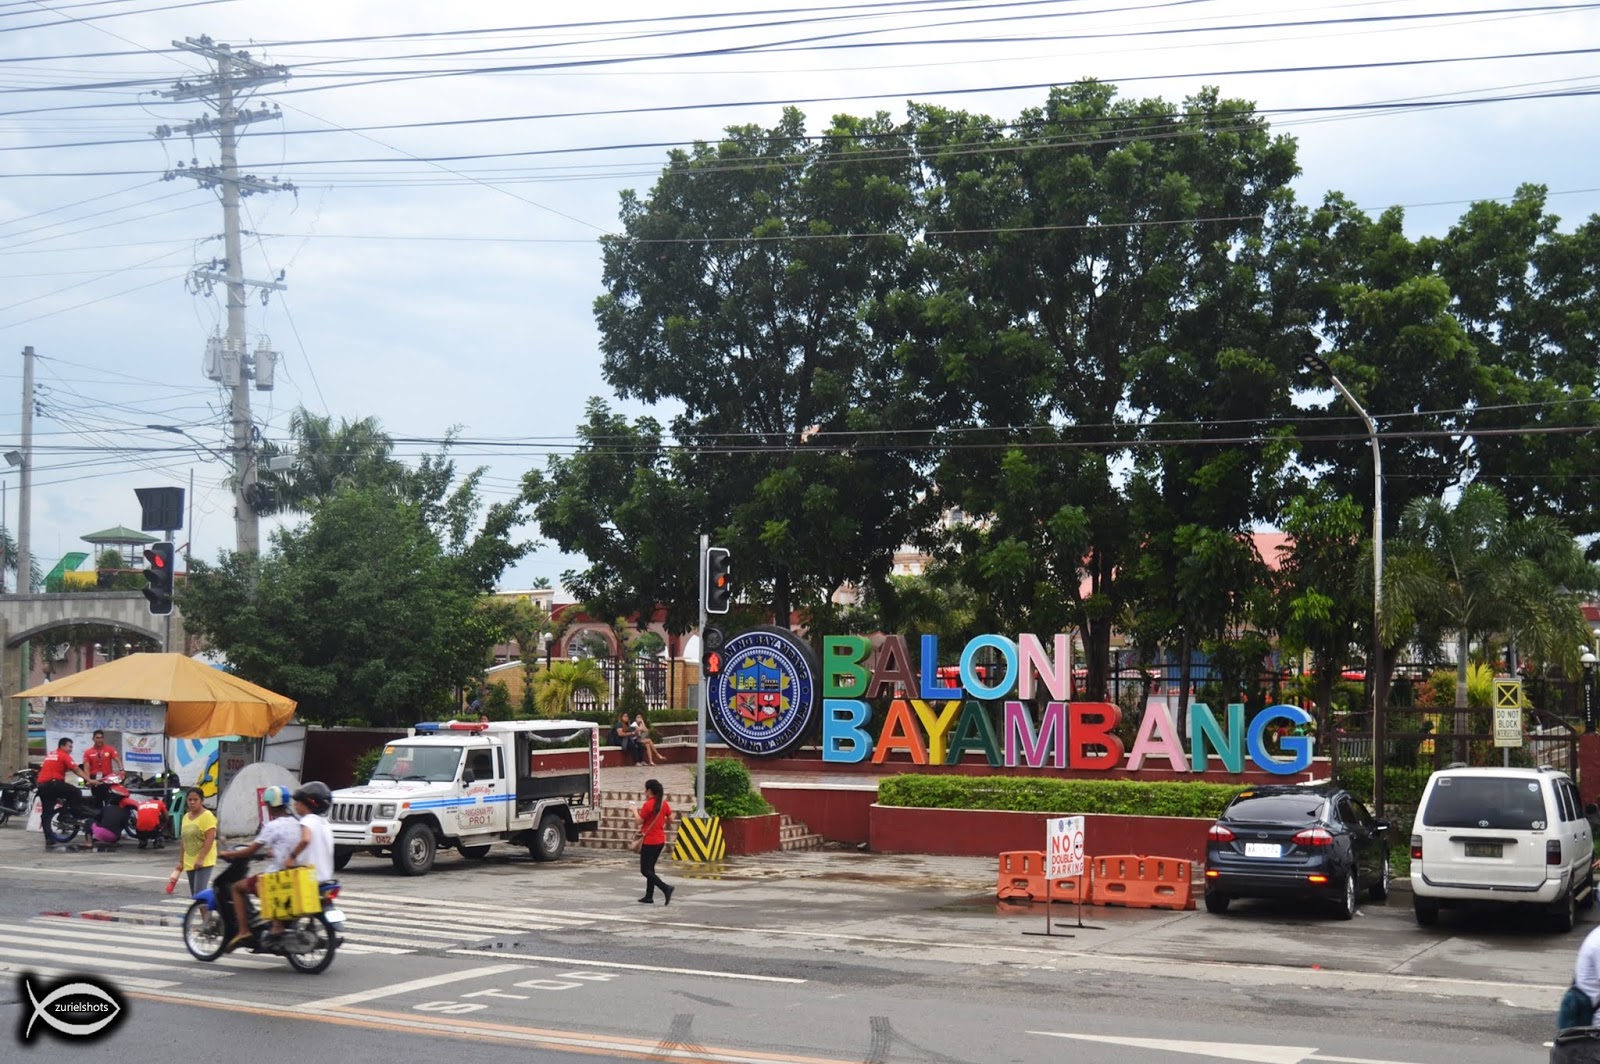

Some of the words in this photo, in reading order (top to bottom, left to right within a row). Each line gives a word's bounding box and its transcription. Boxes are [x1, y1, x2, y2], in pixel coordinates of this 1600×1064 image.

[823, 633, 1070, 701] BALON
[57, 706, 106, 717] HIGHWAY
[112, 706, 151, 717] PUBLIC
[1496, 710, 1505, 719] DO
[1507, 710, 1519, 719] NOT
[54, 719, 120, 729] ASSISTANCE
[125, 719, 151, 729] DESK
[1498, 719, 1518, 728] BLOCK
[822, 699, 1313, 775] BAYAMBANG
[227, 758, 245, 770] STOP
[469, 816, 485, 825] PRO
[575, 809, 589, 823] 042
[376, 836, 391, 844] 042
[1052, 834, 1070, 853] NO
[1052, 853, 1074, 864] DOUBLE
[1052, 862, 1083, 875] PARKING
[412, 971, 620, 1014] STOP
